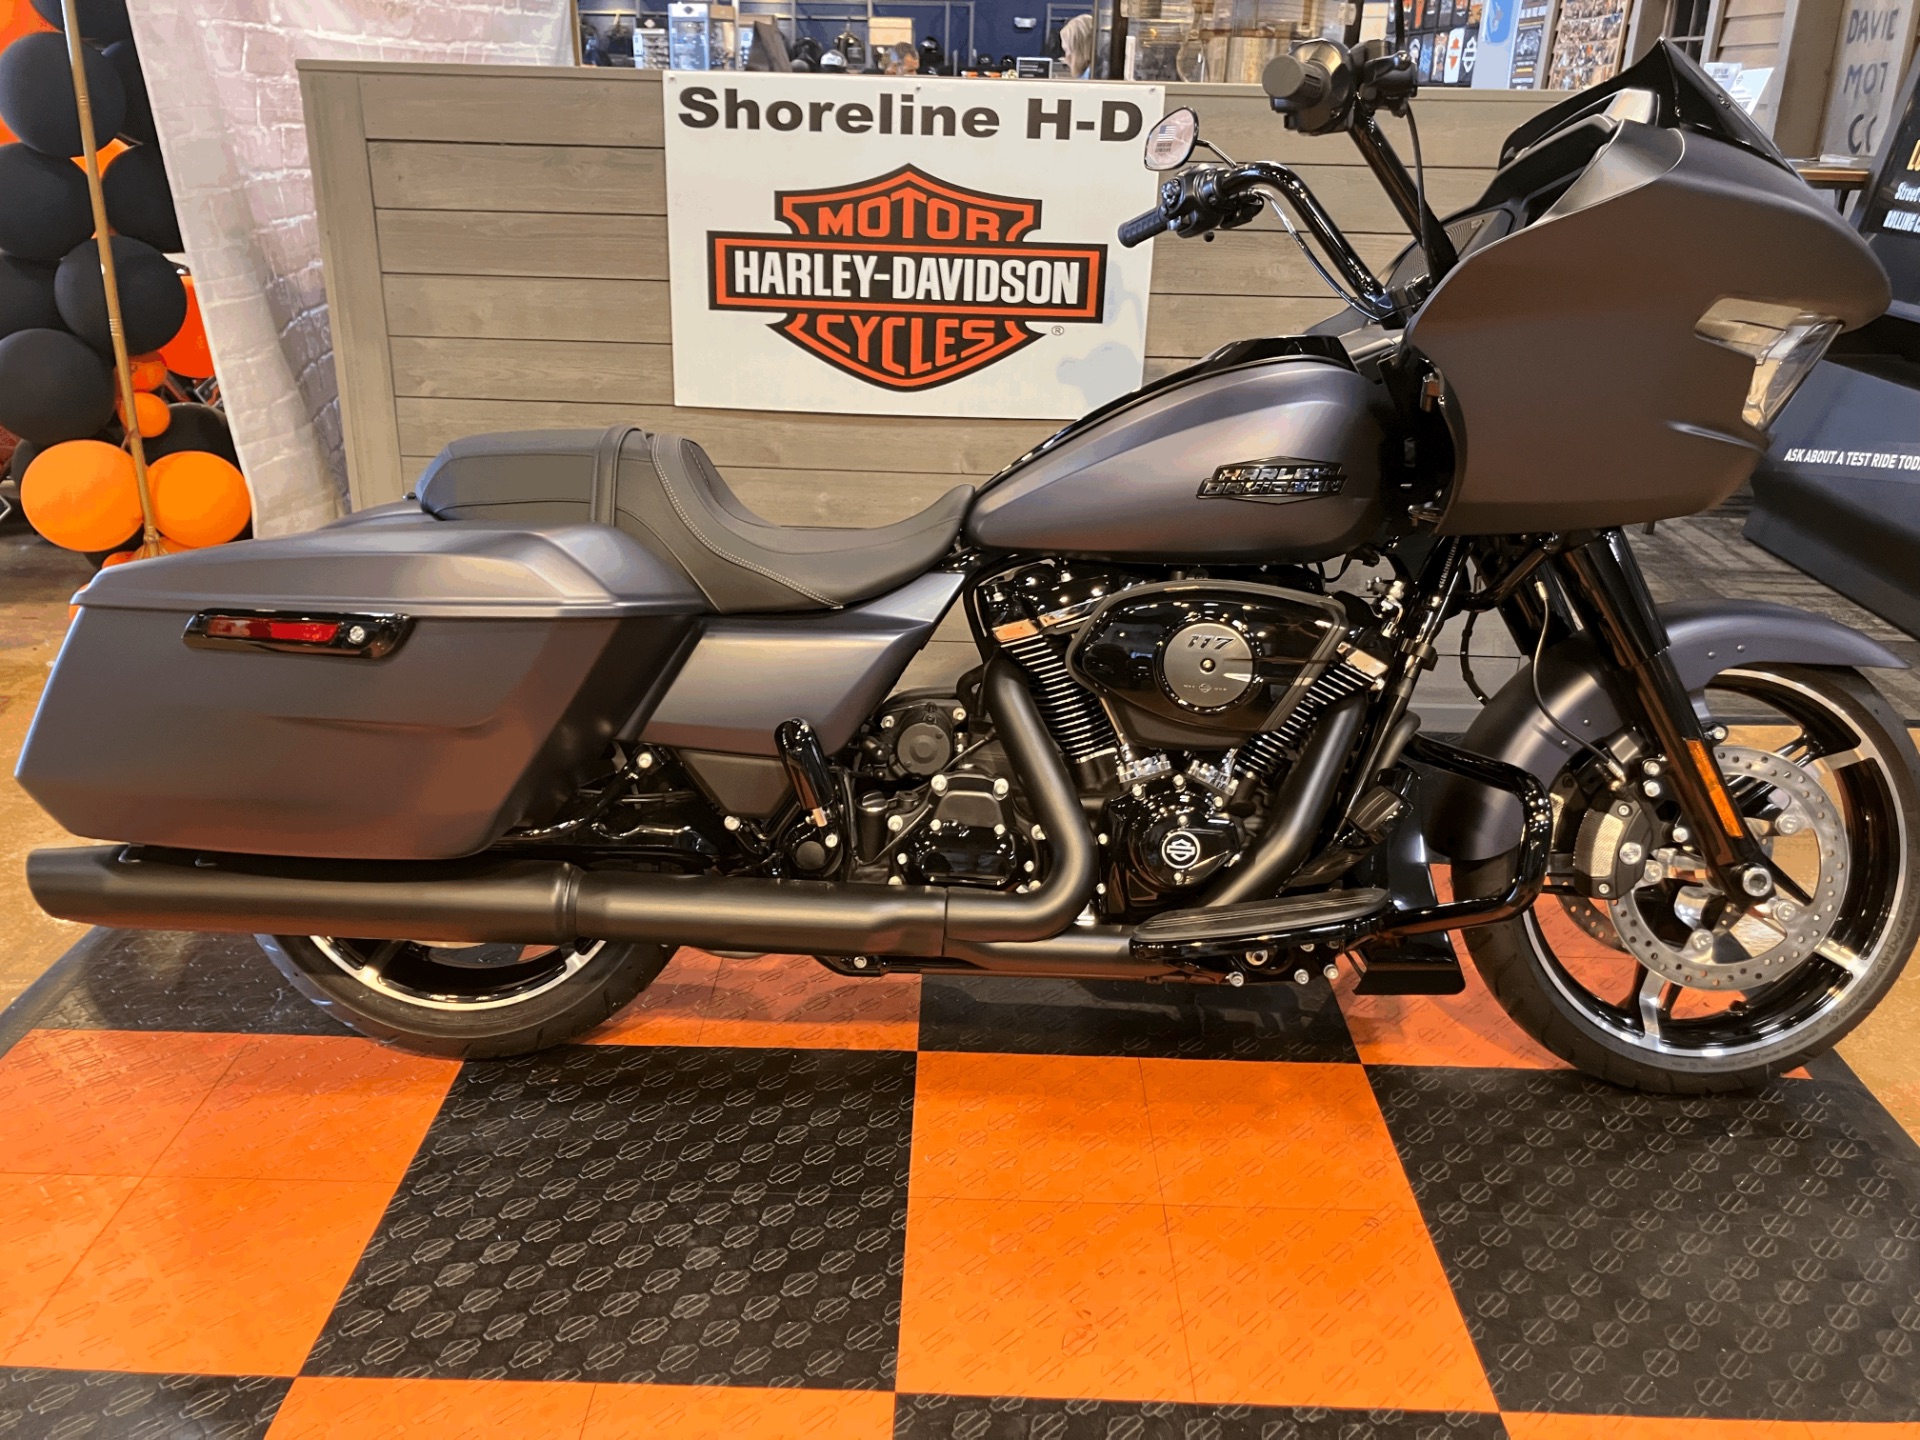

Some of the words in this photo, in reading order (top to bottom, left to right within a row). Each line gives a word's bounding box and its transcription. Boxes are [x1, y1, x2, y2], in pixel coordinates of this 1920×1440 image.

[678, 86, 1000, 138] Shoreline
[1026, 98, 1143, 142] H-D
[817, 187, 1001, 242] MOTOR
[734, 250, 1080, 305] HARLEY-DAVIDSON
[816, 313, 996, 376] CYCLES
[1783, 448, 1806, 463] ASK
[1803, 449, 1838, 465] ABOUT
[1835, 450, 1845, 466] A
[1845, 451, 1873, 467] TEST
[1870, 453, 1899, 469] RIDE
[1186, 634, 1236, 650] 117
